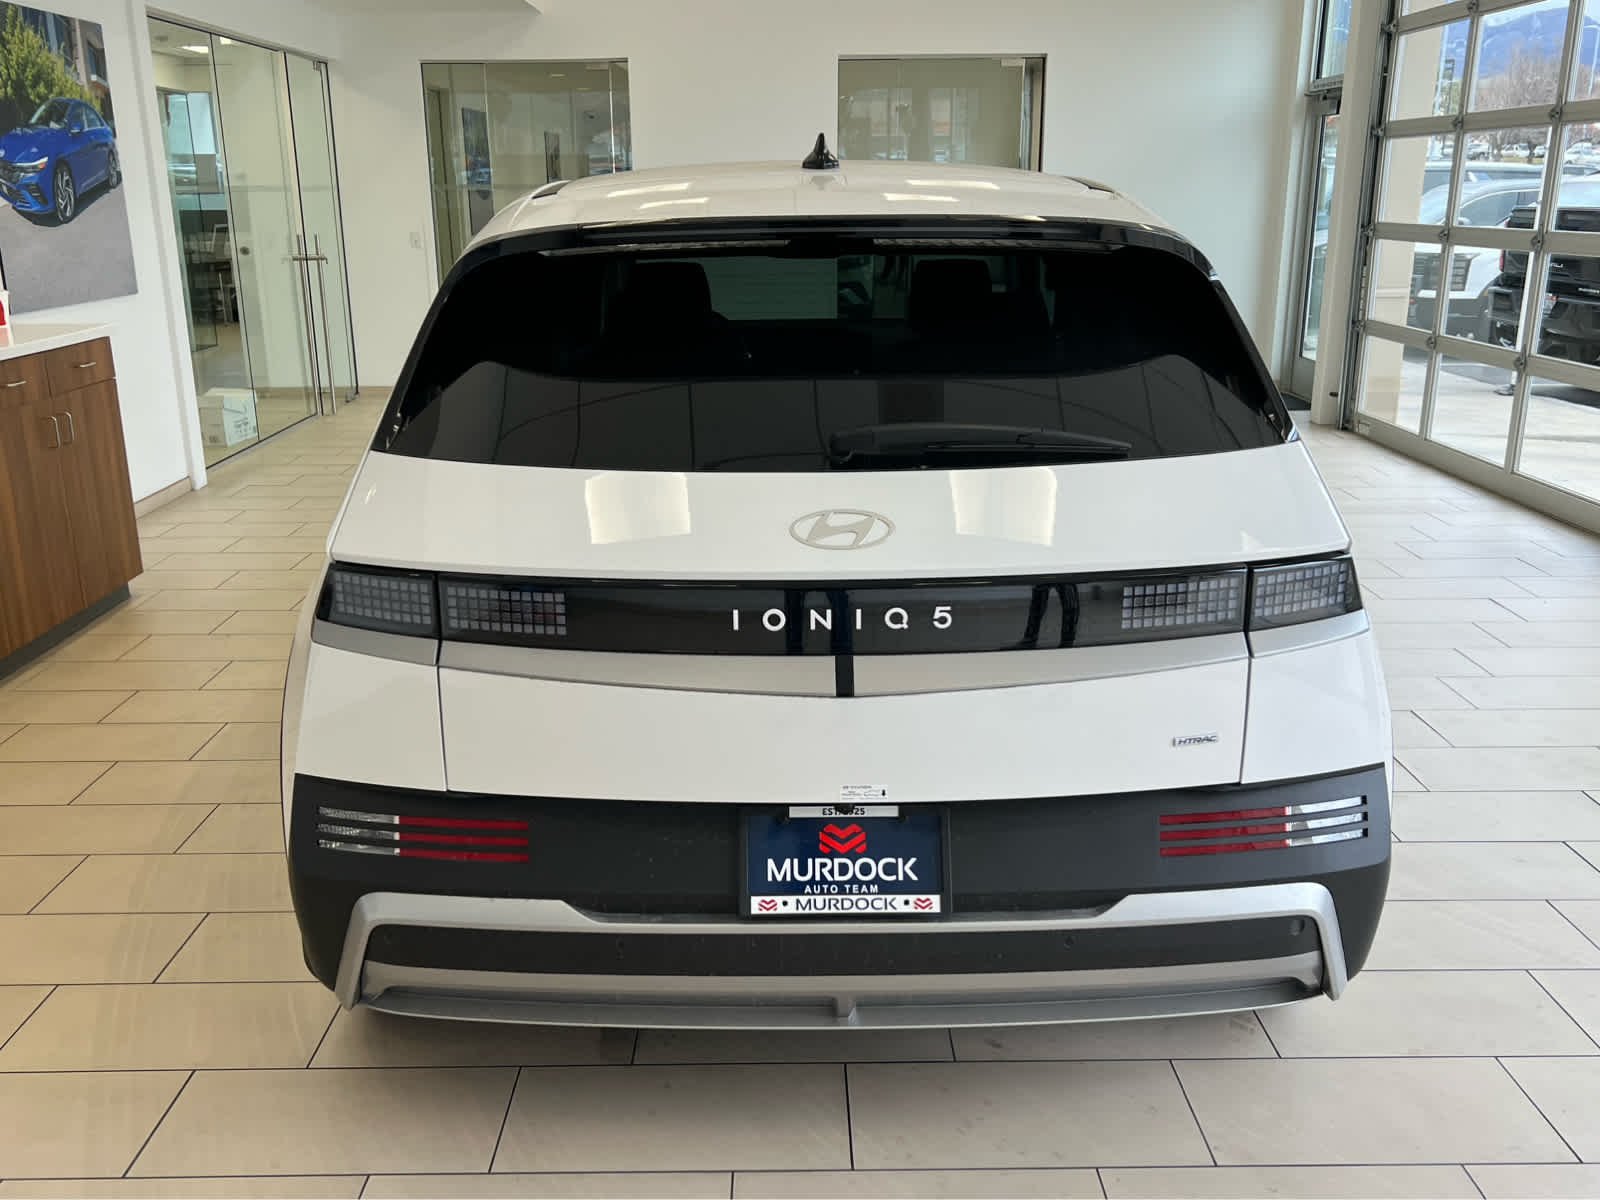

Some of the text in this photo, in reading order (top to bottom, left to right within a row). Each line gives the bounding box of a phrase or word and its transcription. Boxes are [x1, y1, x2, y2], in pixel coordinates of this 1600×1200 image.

[732, 606, 953, 631] IONIQ 5
[1178, 735, 1217, 745] HTRAC
[767, 857, 919, 882] MURDOCK
[804, 884, 879, 894] AUTO TEAM
[795, 897, 898, 911] MURDOCK
